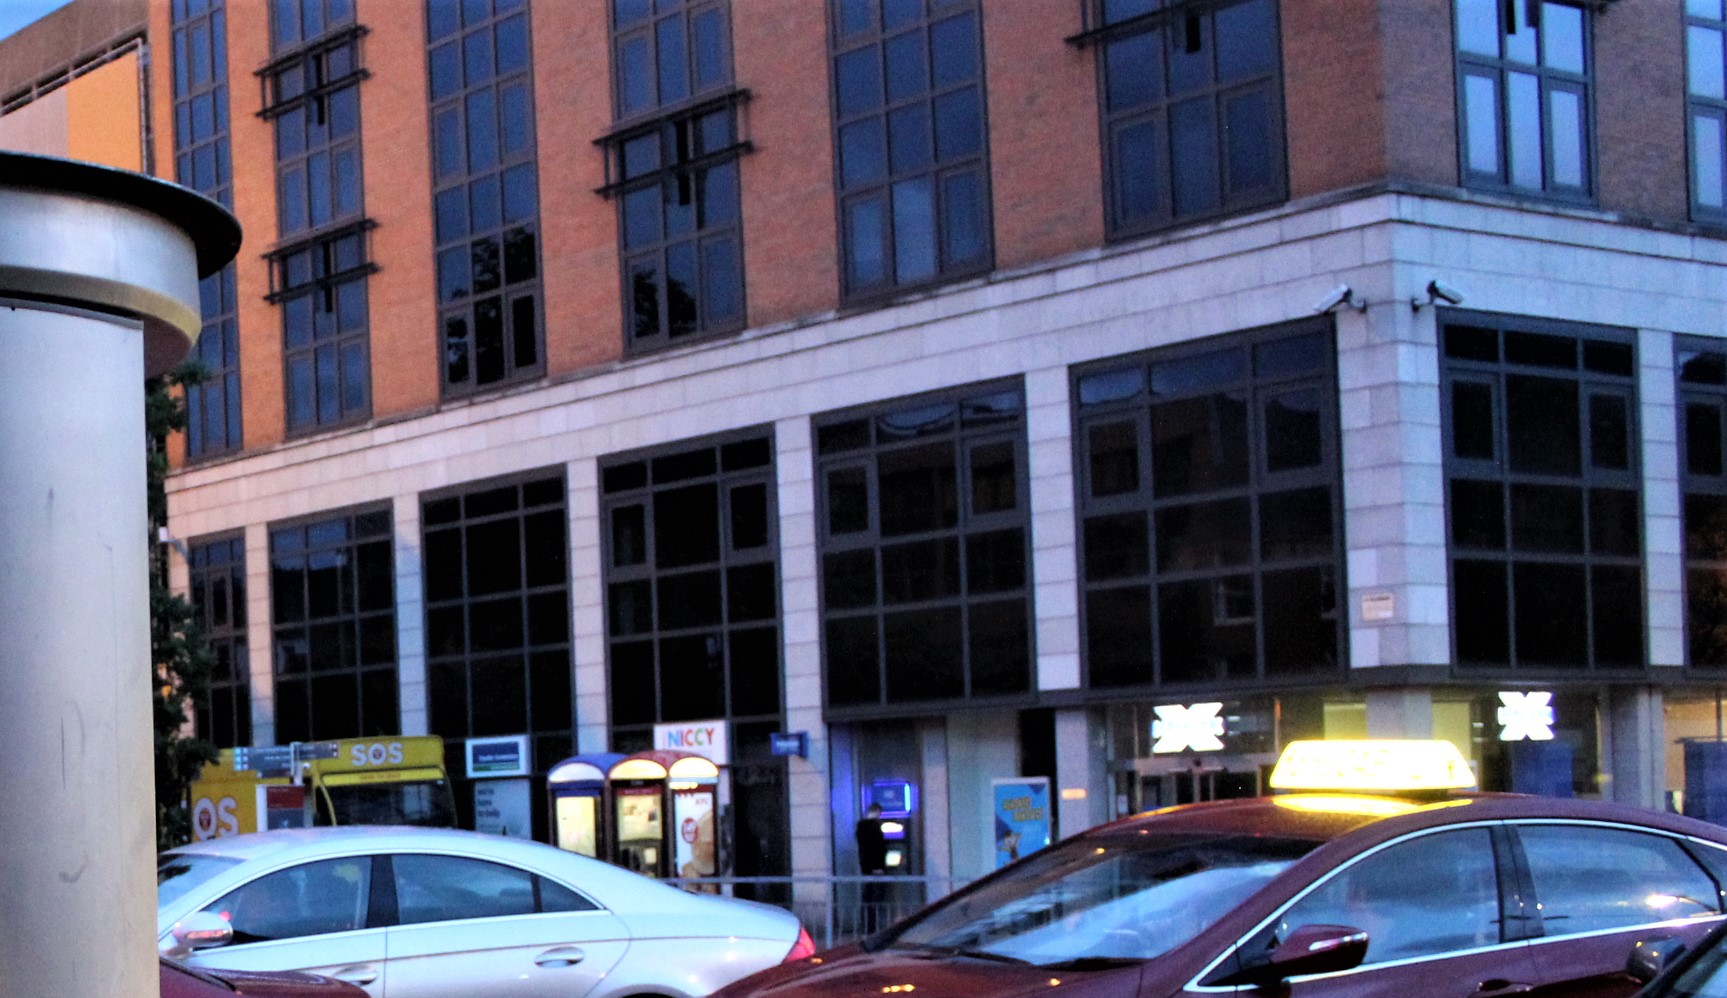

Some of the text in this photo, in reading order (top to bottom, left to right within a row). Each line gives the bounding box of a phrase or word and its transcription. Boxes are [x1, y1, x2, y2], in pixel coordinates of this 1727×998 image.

[668, 728, 714, 747] NICCY
[351, 742, 403, 766] SOS
[193, 796, 239, 840] OS
